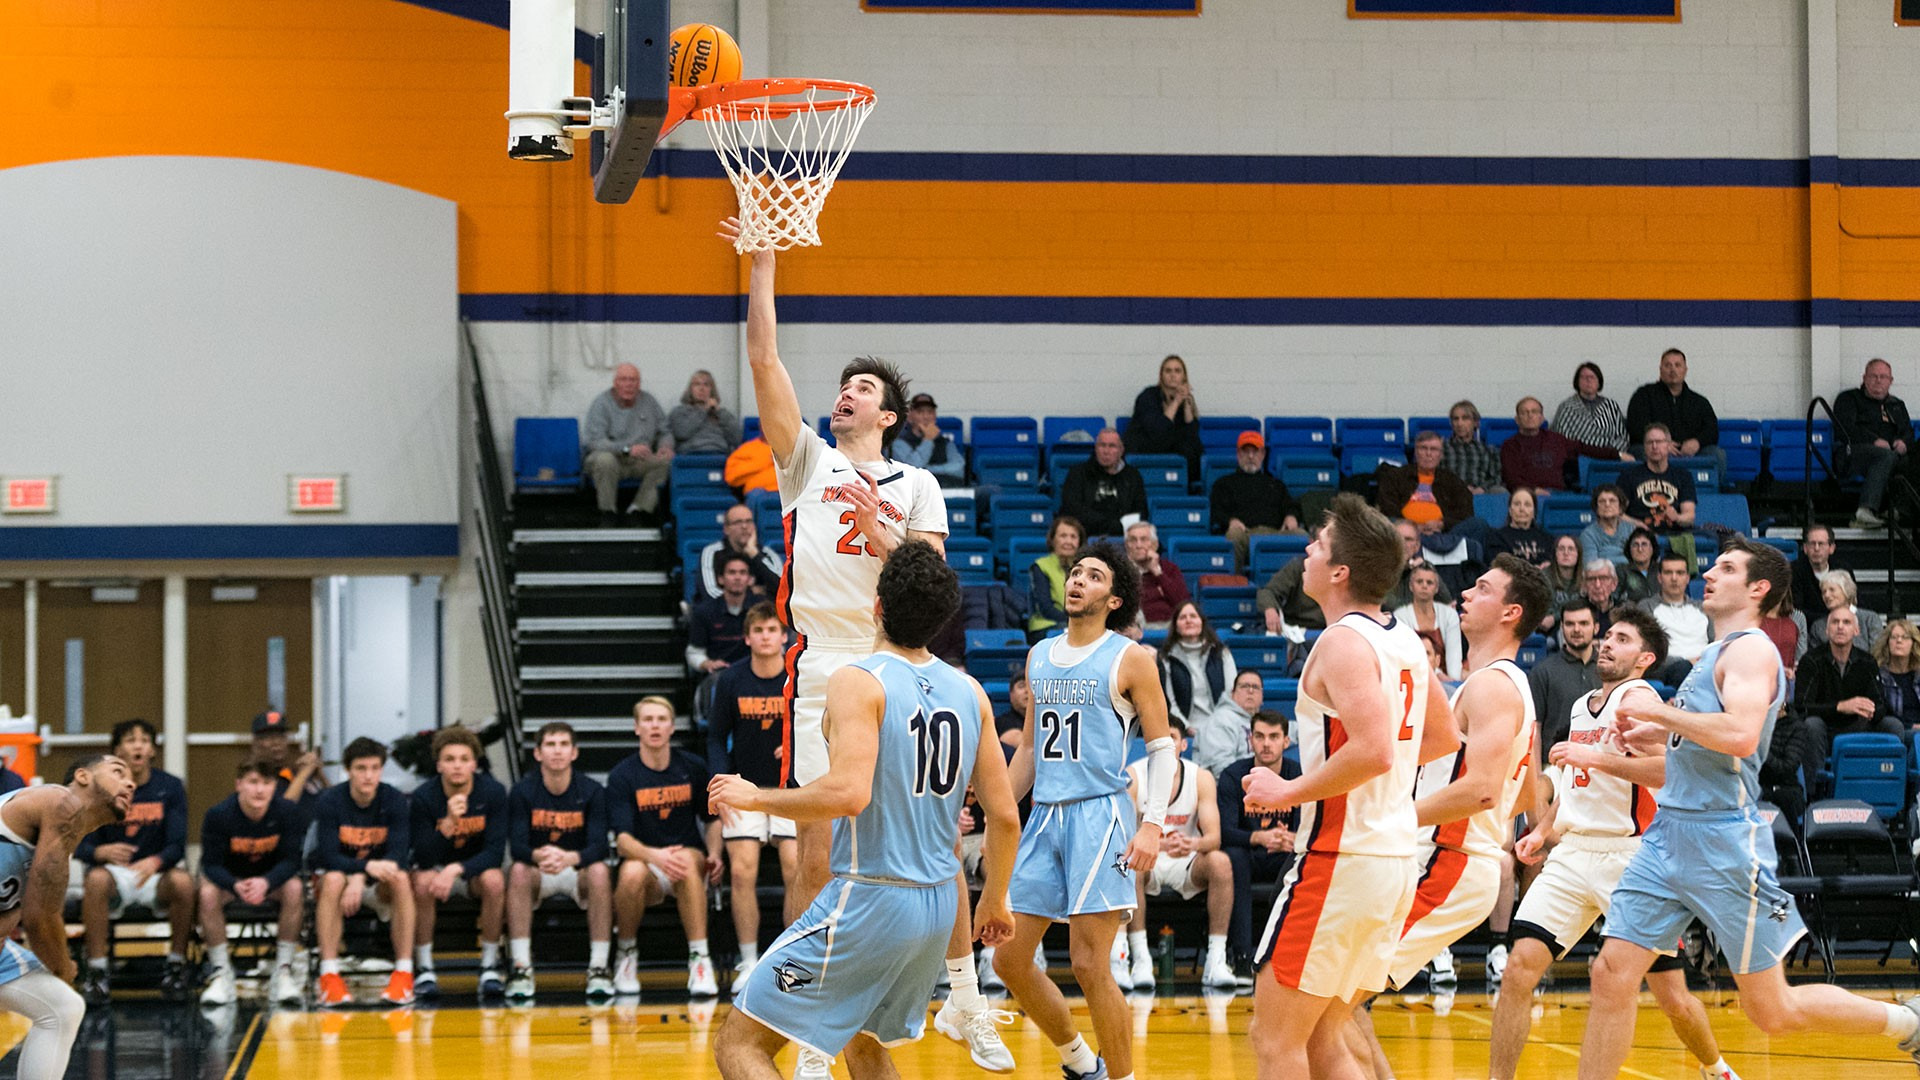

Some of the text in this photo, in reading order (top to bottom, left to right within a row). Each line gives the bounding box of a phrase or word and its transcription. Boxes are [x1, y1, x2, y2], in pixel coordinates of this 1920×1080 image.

[688, 39, 712, 87] Wilso
[737, 696, 785, 715] WHEATO
[907, 703, 963, 799] 10
[1041, 708, 1082, 762] 21
